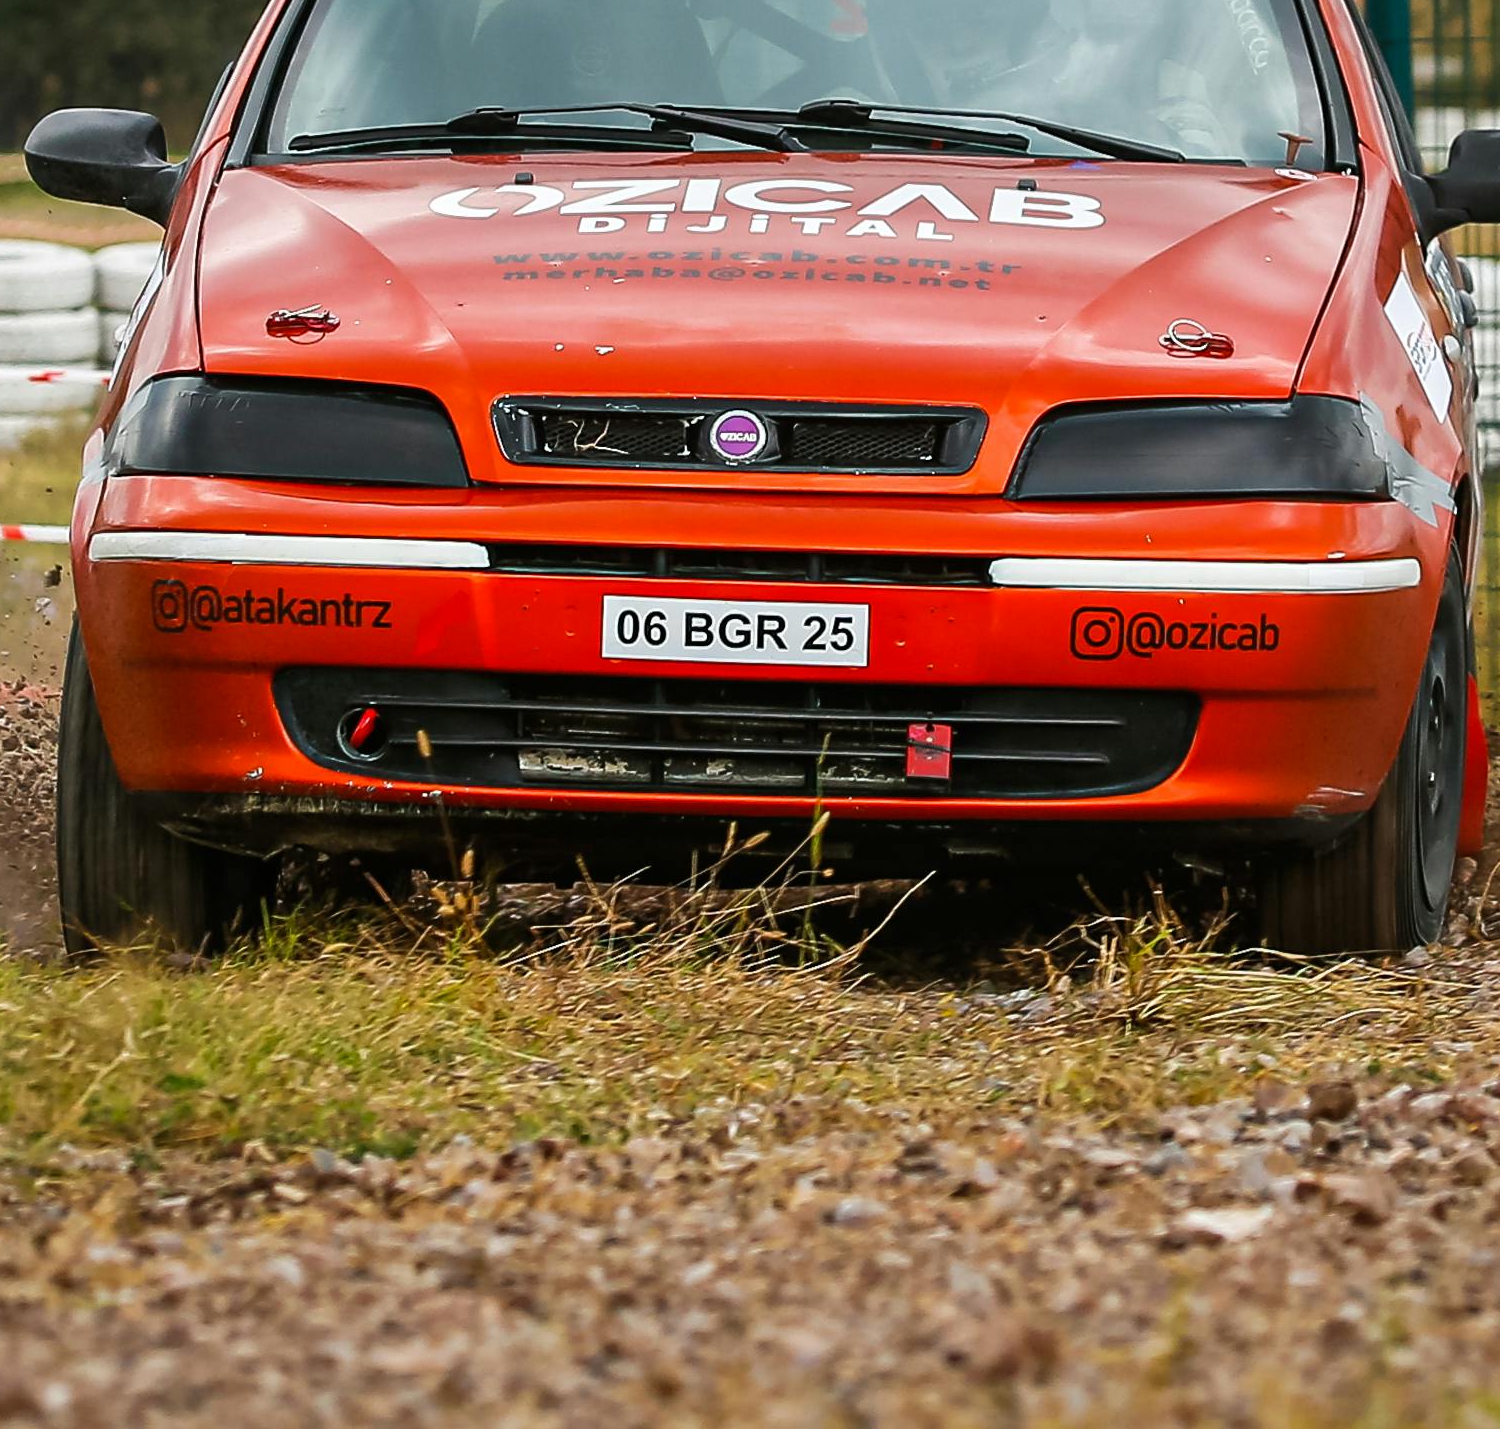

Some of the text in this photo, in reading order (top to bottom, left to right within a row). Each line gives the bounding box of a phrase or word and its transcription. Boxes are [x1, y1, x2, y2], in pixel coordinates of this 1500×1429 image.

[428, 178, 1106, 230] OZICAB
[493, 247, 1022, 275] www.ozicab.com.tr
[502, 266, 992, 291] merhaba@ozicab.net
[190, 585, 393, 632] @atakantrz
[616, 609, 854, 651] 06 BGR 25
[1125, 612, 1280, 658] @ozicab
